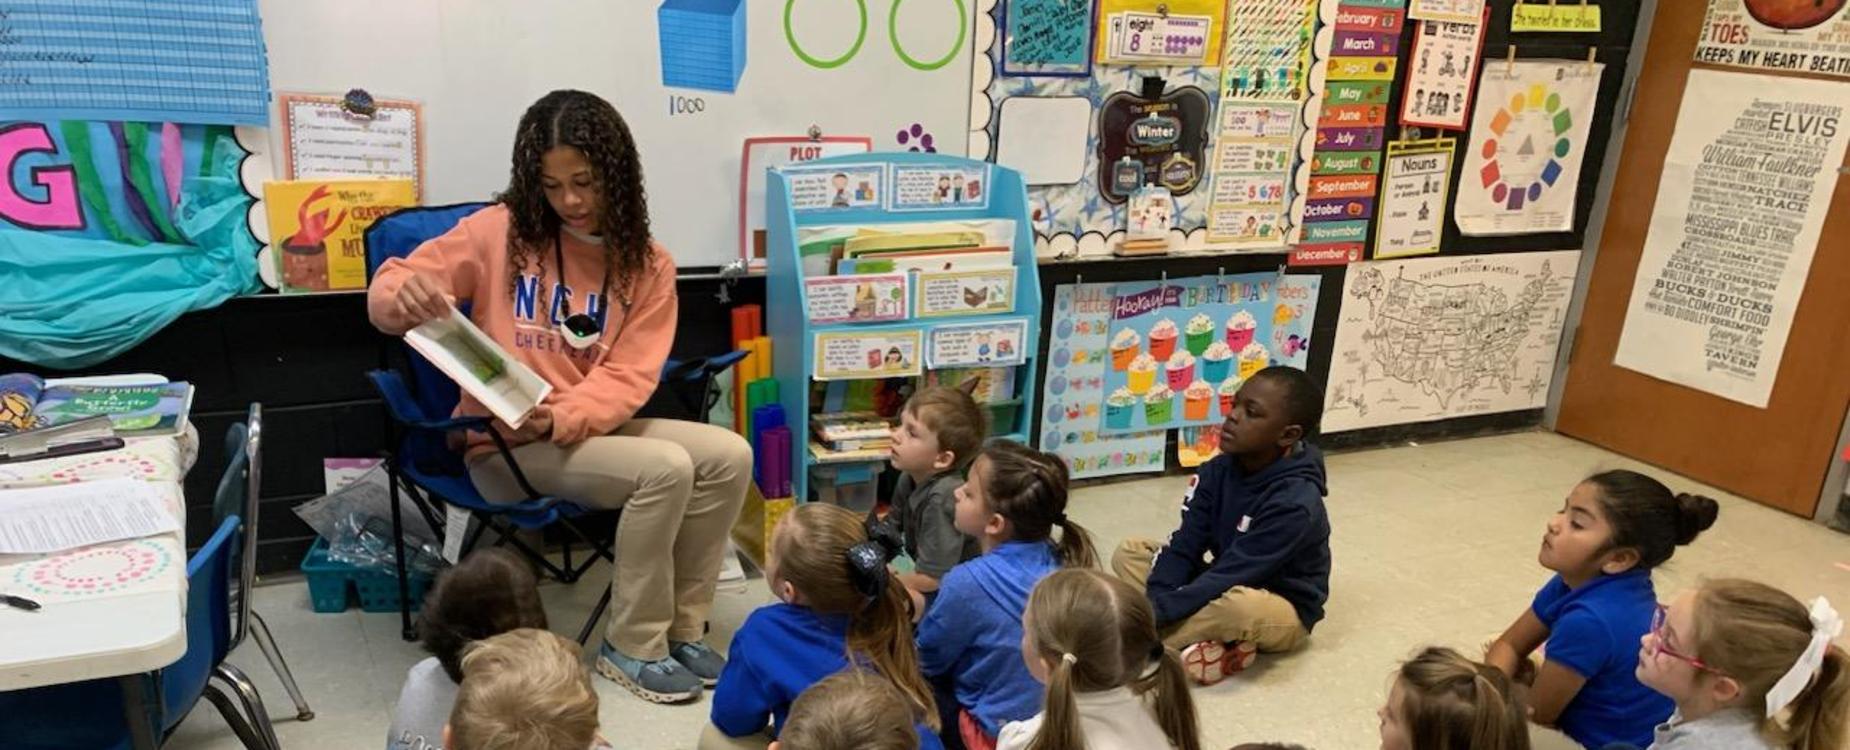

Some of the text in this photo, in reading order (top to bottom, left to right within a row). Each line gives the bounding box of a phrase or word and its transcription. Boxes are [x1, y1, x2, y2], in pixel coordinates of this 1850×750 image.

[1129, 19, 1155, 32] eight
[1711, 23, 1750, 45] TOES
[1130, 33, 1141, 52] 8
[1343, 38, 1375, 50] March
[1696, 46, 1735, 63] KEEPS
[1738, 48, 1760, 65] MY
[1762, 51, 1808, 70] HEART
[1344, 62, 1368, 75] April
[1339, 87, 1362, 101] May
[670, 95, 705, 116] 1000
[1338, 110, 1361, 121] June
[1137, 124, 1175, 138] Winter
[1768, 112, 1838, 136] ELVIS
[1335, 133, 1356, 147] July
[1766, 132, 1831, 145] PRESLEY
[789, 147, 822, 161] PLOT
[1700, 144, 1822, 177] William Faulkner
[1324, 157, 1359, 171] August
[1402, 157, 1437, 172] Nouns
[0, 122, 88, 231] G
[1317, 180, 1370, 194] September
[1748, 187, 1809, 200] NATCHEZ
[1303, 203, 1344, 217] October
[1755, 196, 1807, 211] TRACE
[1311, 225, 1363, 239] November
[1740, 223, 1768, 238] BLUES
[1296, 248, 1347, 260] December
[1722, 251, 1758, 261] JIMMY
[1667, 262, 1775, 289] ROBERT JOHNSON
[1186, 281, 1271, 309] BIRTHDAY
[1655, 279, 1705, 296] BUCKS
[1718, 294, 1771, 312] DUCKS
[1114, 286, 1166, 320] Hooray!
[1688, 298, 1769, 325] COMFORT FOOD
[1705, 350, 1756, 367] TAVERN
